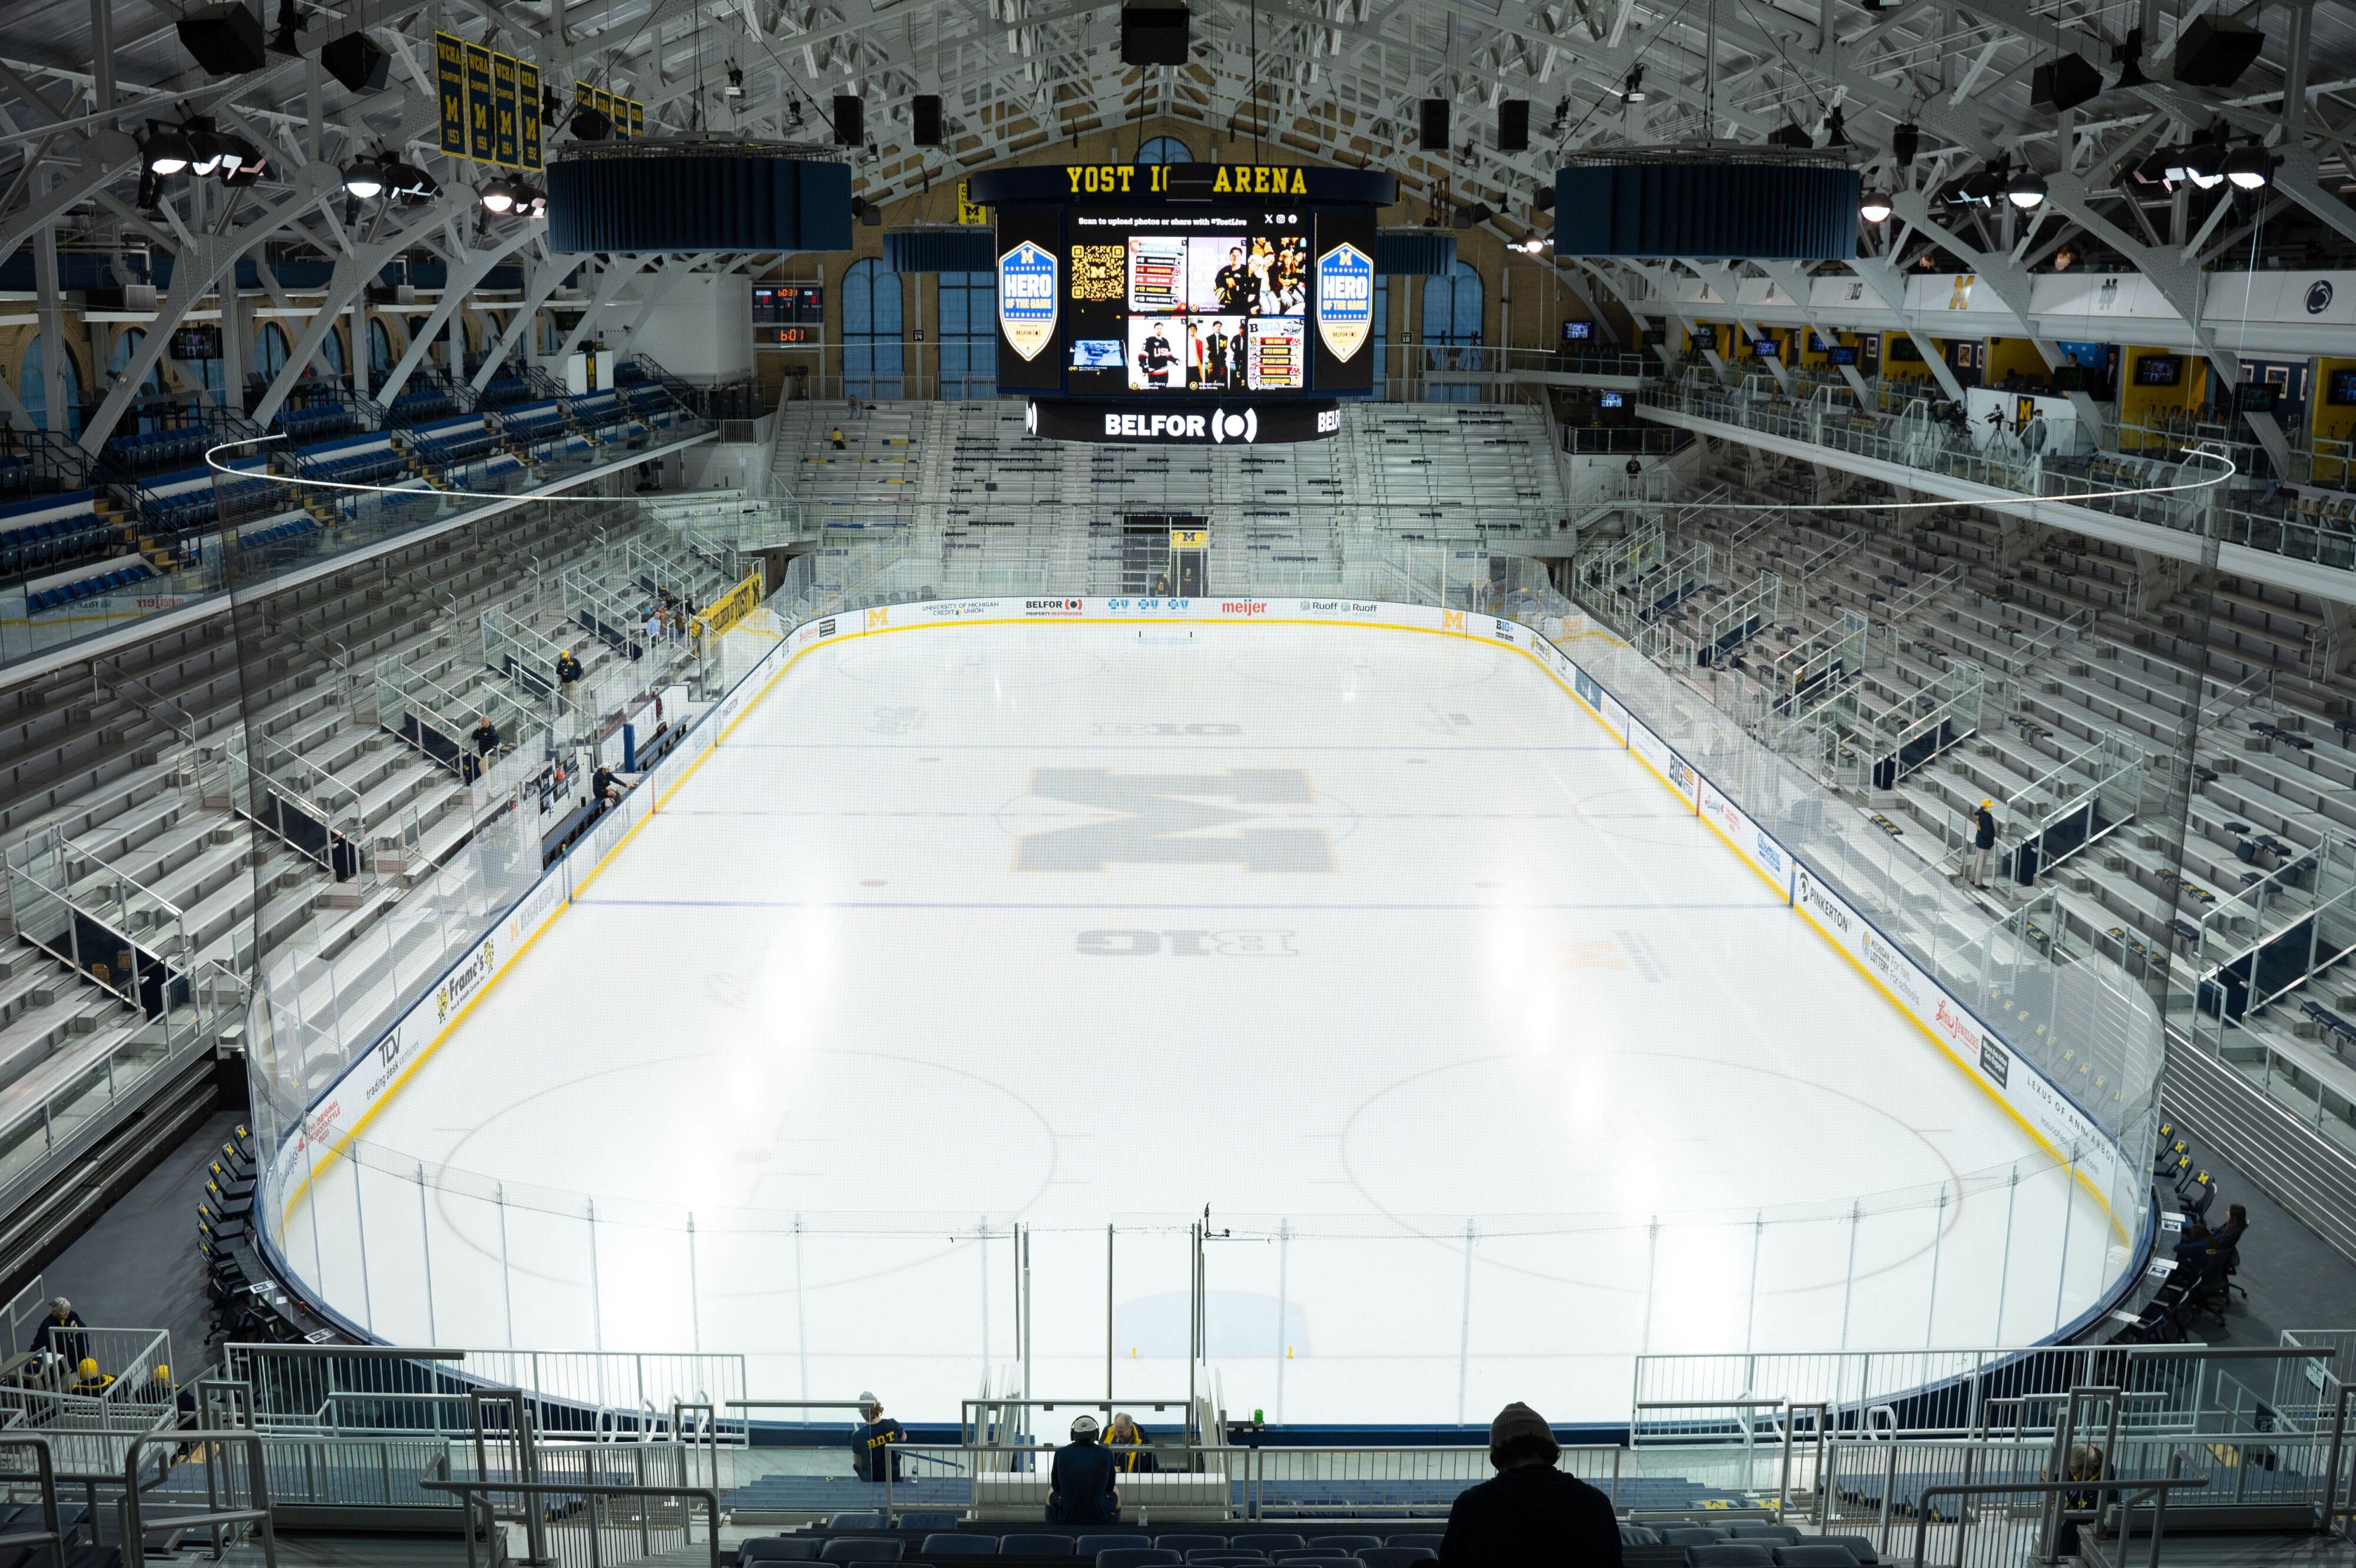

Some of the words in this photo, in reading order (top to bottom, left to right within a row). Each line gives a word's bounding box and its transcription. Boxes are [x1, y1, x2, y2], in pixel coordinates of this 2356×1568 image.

[438, 42, 461, 65] WCHA
[468, 52, 489, 74] WCHA
[441, 70, 461, 84] CHAMPIONS
[495, 61, 514, 83] WCHA
[445, 95, 459, 123] M
[475, 103, 487, 130] M
[500, 110, 512, 136] M
[526, 116, 537, 141] M
[1067, 166, 1134, 193] YOST
[1213, 166, 1307, 194] ARENA
[966, 206, 980, 216] M
[1107, 217, 1133, 227] upload
[1134, 217, 1159, 227] photos
[1170, 217, 1192, 226] share
[1193, 217, 1210, 226] with
[1211, 218, 1247, 226] #YostLive
[1021, 249, 1034, 264] M
[1339, 251, 1352, 266] M
[1005, 273, 1052, 297] HERO
[1322, 275, 1368, 299] HERO
[1948, 276, 1974, 309] M
[763, 296, 769, 305] 0
[810, 295, 817, 305] 0
[1005, 299, 1015, 309] OF
[1015, 299, 1030, 309] THE
[1030, 299, 1051, 309] GAME
[1323, 300, 1332, 310] OF
[1333, 300, 1347, 310] THE
[1347, 300, 1367, 310] GAME
[2019, 399, 2032, 421] M
[1105, 414, 1205, 437] BELFOR
[1183, 532, 1196, 541] M
[868, 607, 889, 627] M
[922, 603, 957, 611] UNIVERSITY
[1222, 598, 1267, 616] meijer
[1312, 601, 1338, 611] Ruoff
[1352, 603, 1378, 613] Ruoff
[1442, 609, 1464, 630] M
[521, 898, 538, 932] MICHIGAN
[1810, 887, 1848, 933] PINKERTON
[1871, 939, 1890, 963] MICHIGAN
[1870, 950, 1890, 975] LOTTERY
[449, 952, 484, 1002] Frame's
[378, 1026, 401, 1069] TDV
[366, 1075, 386, 1100] trading
[386, 1060, 399, 1080] desk
[399, 1039, 419, 1066] ventures
[2027, 1075, 2051, 1104] LEXUS
[2055, 1102, 2066, 1114] OF
[2069, 1114, 2086, 1136] ANN
[2091, 1135, 2115, 1167] ARBOR
